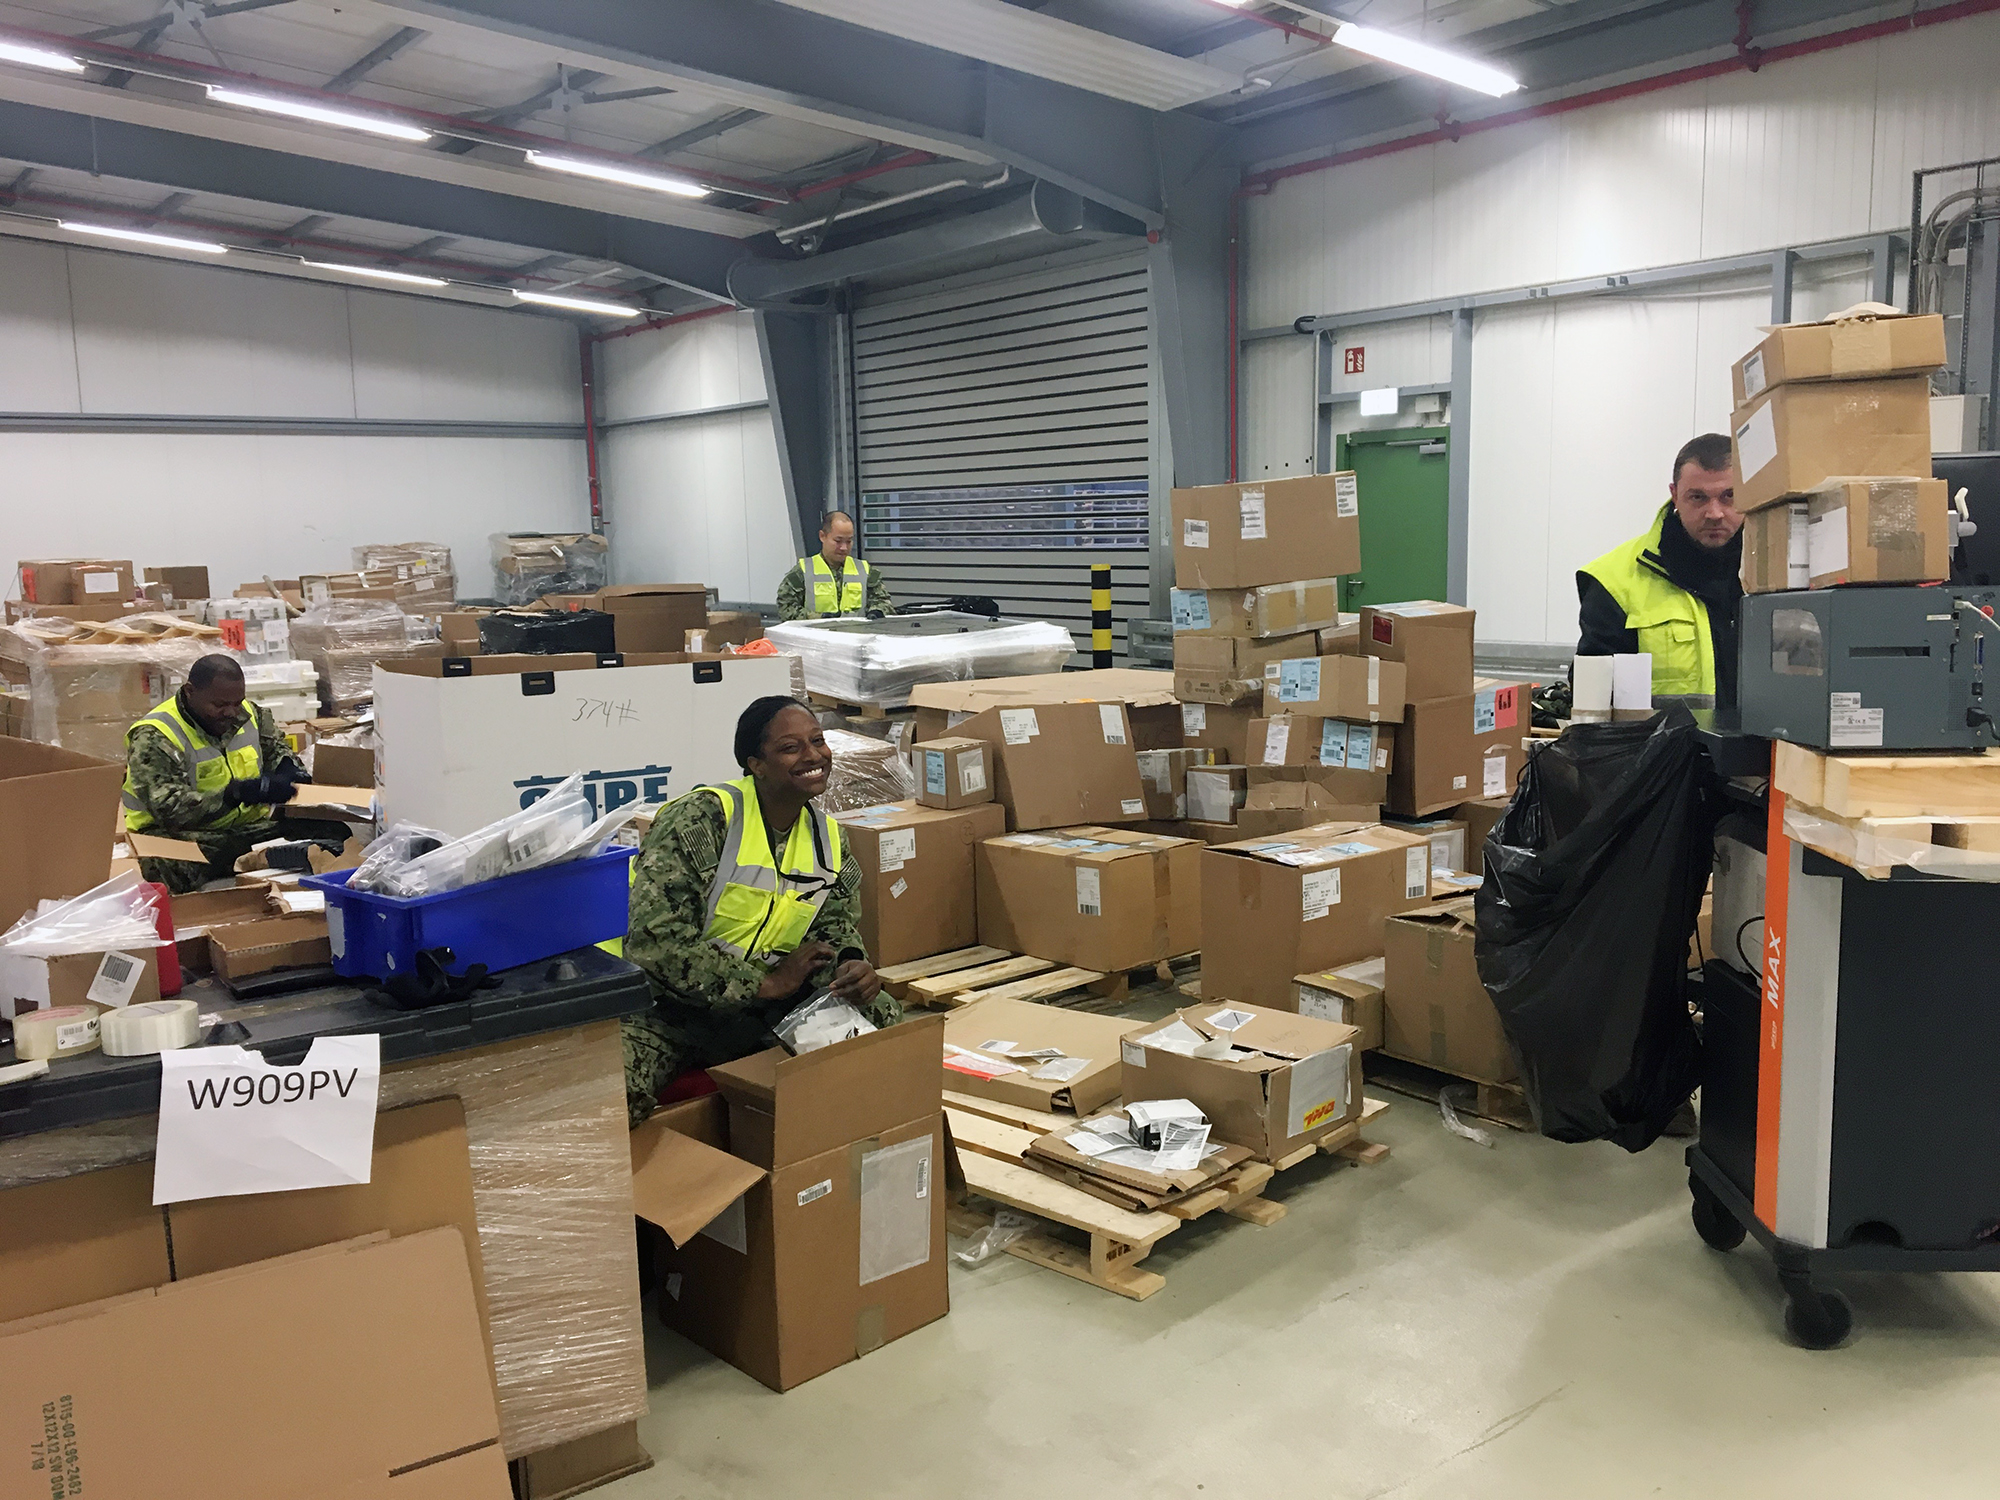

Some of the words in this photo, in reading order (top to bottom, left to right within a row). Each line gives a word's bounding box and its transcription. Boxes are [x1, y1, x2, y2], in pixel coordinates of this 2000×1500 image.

[1767, 926, 1781, 1009] MAX
[187, 1066, 359, 1110] W909PV
[1304, 1101, 1335, 1127] DHL
[49, 1456, 62, 1472] SW
